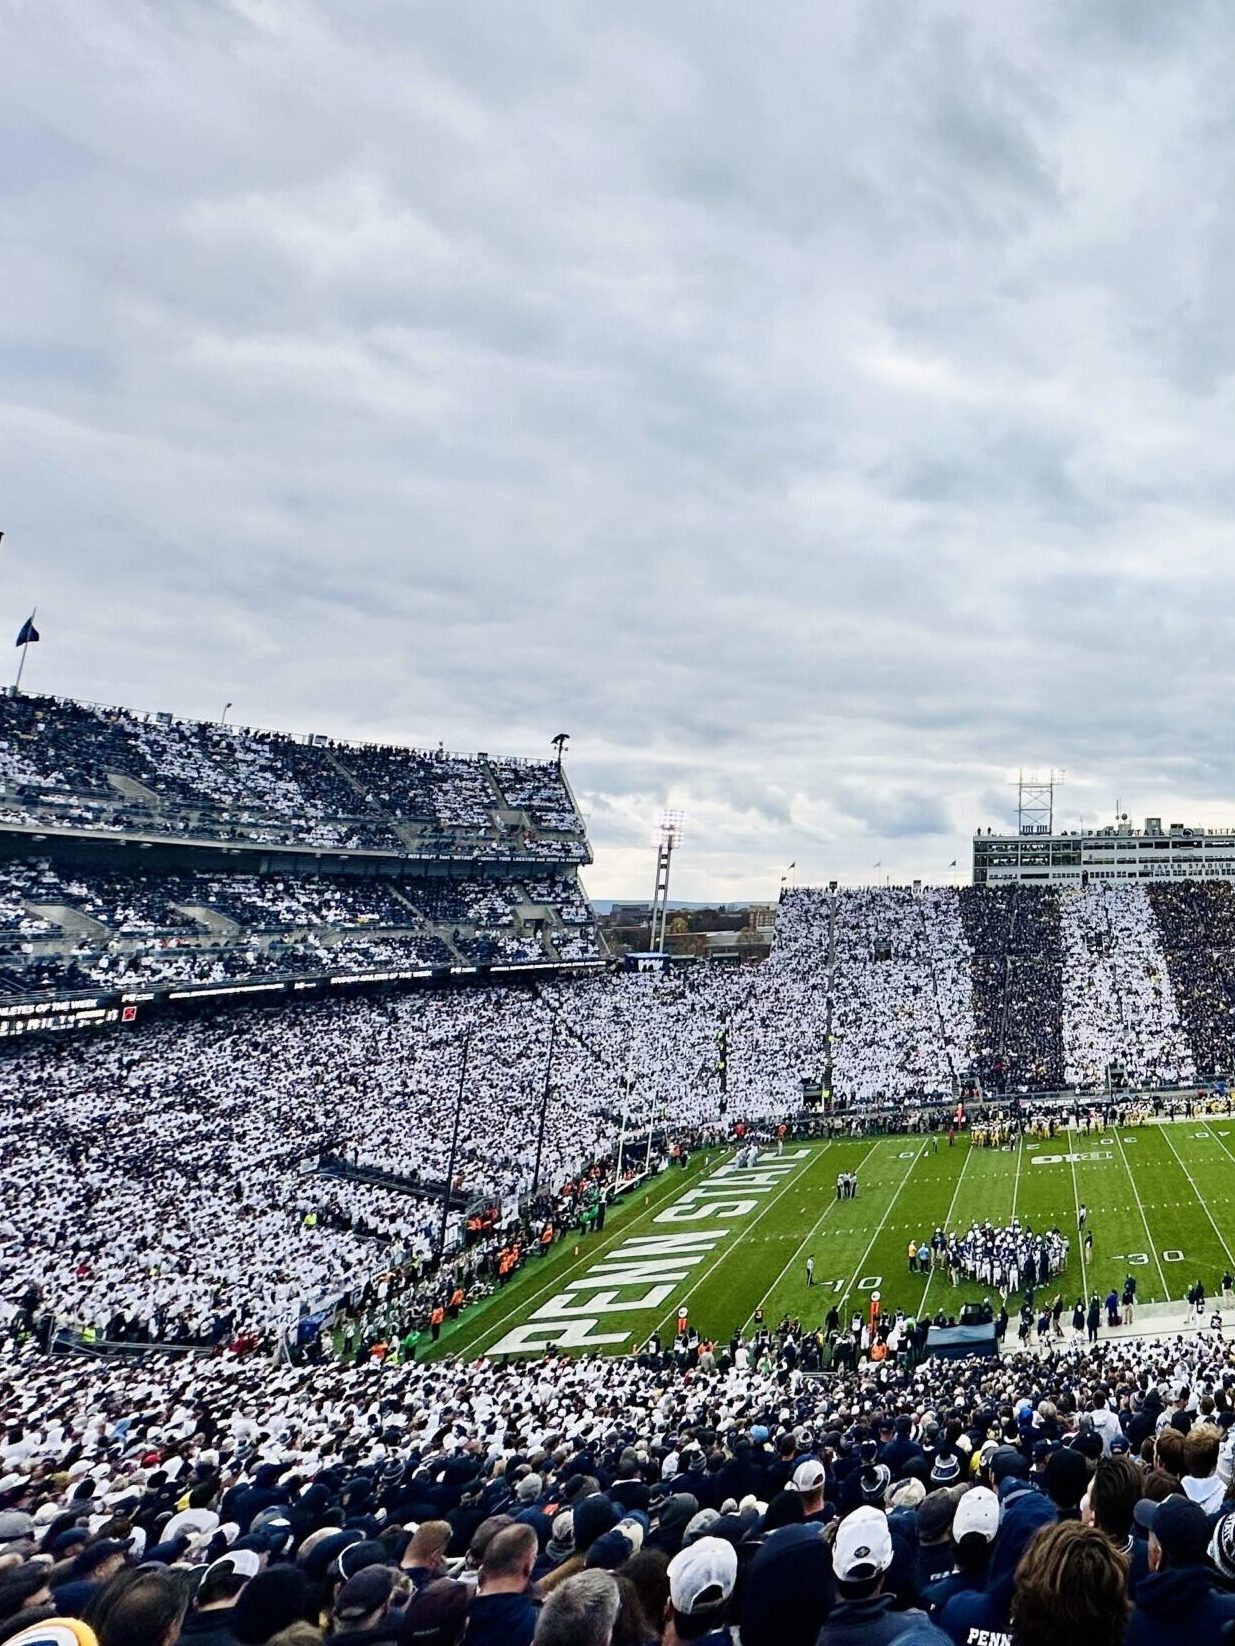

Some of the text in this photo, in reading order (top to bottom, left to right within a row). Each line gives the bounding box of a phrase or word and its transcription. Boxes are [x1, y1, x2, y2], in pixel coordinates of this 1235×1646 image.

[35, 1003, 52, 1013] OF
[52, 1001, 71, 1012] THE
[71, 999, 99, 1010] WEEK
[652, 1148, 813, 1223] STATE
[1127, 1250, 1186, 1265] 30
[484, 1229, 731, 1356] PENN
[832, 1276, 883, 1293] 10
